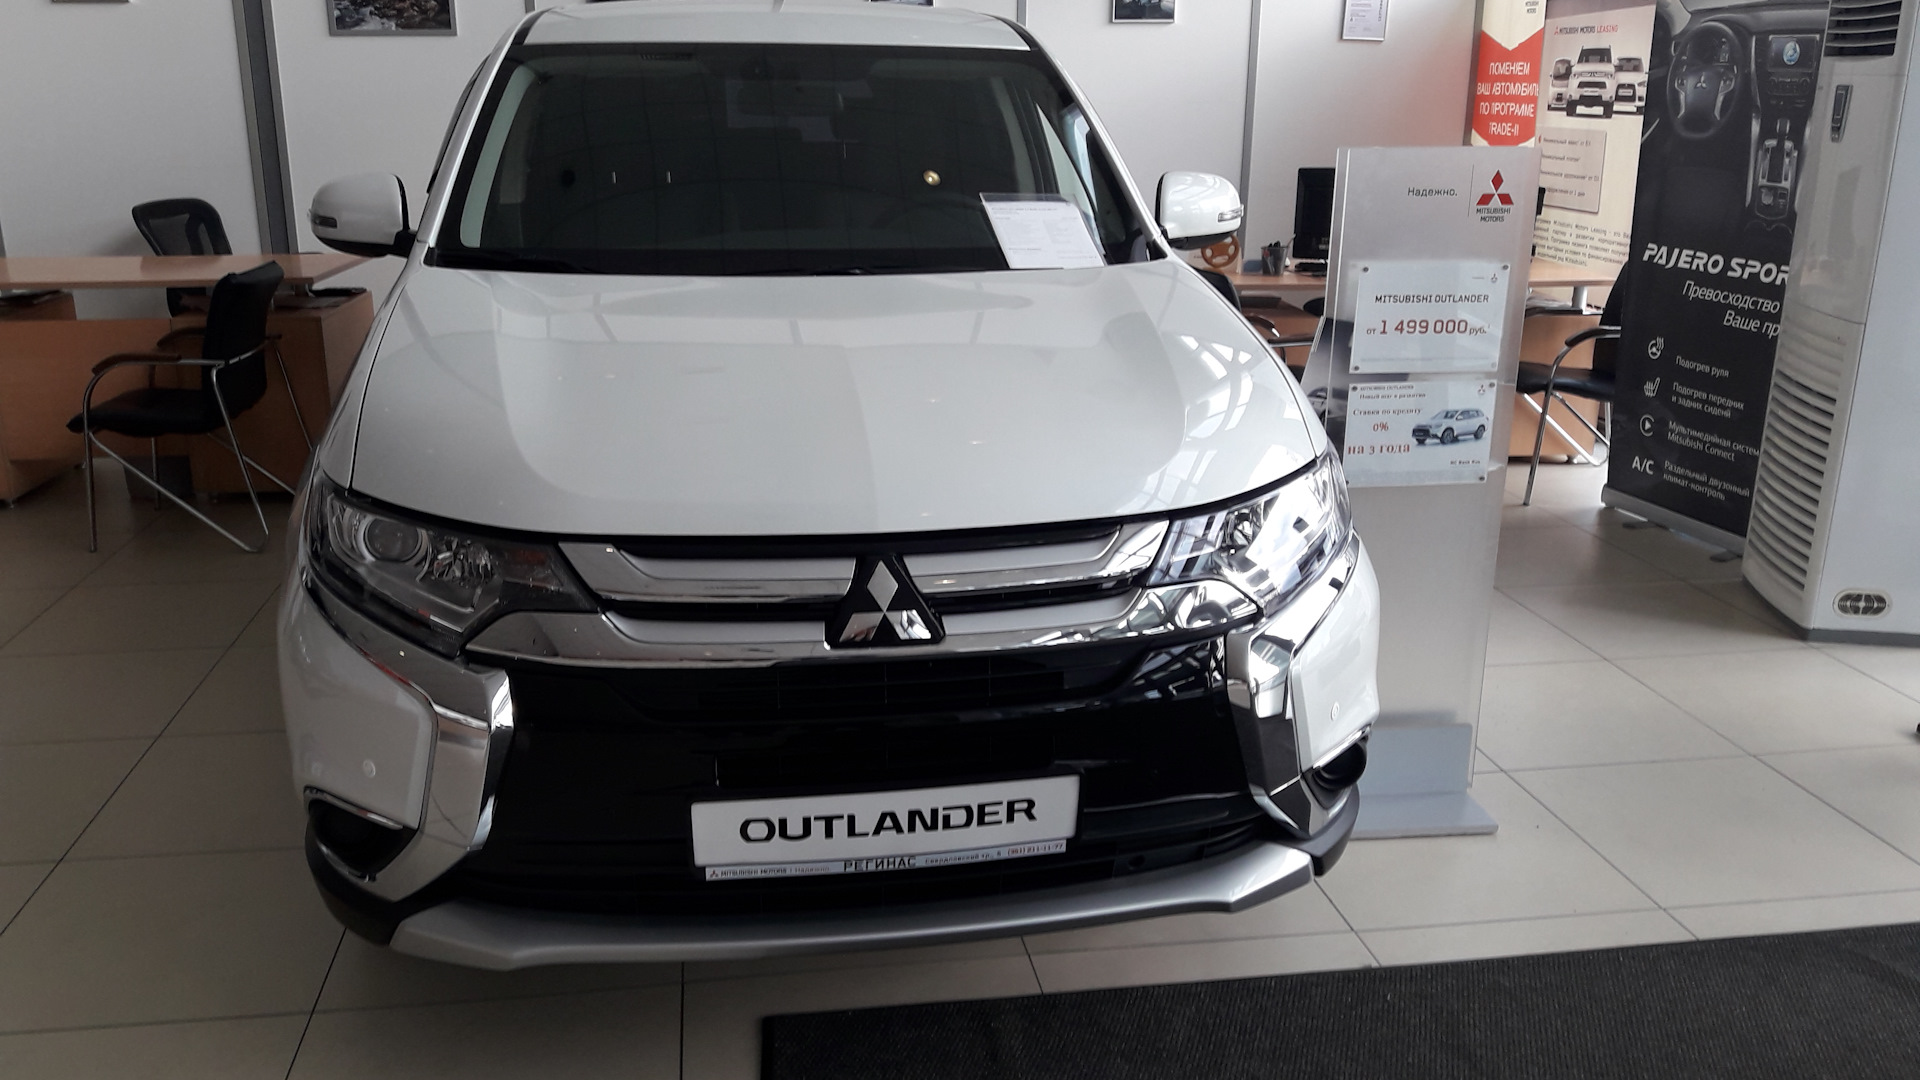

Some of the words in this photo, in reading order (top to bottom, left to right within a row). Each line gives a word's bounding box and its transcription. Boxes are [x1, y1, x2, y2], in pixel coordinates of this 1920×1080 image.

[1597, 24, 1619, 34] LEASING
[1489, 61, 1530, 76] ПОМЕНЯЕМ
[1477, 82, 1490, 96] ВАШ
[1480, 102, 1490, 116] ПО
[1491, 102, 1535, 118] ПРОГРАММЕ
[1407, 187, 1458, 198] Надежно.
[1476, 207, 1511, 215] MITSUBISHI
[1480, 215, 1505, 223] MOTORS
[1642, 242, 1724, 275] PAJERO
[1375, 294, 1433, 304] MITSUBISHI
[1435, 294, 1489, 304] OUTLANDER
[1683, 280, 1781, 314] Превосходство
[1366, 327, 1377, 335] от
[1380, 320, 1388, 335] 1
[1394, 319, 1429, 335] 499
[1433, 319, 1468, 335] 000
[1469, 326, 1487, 337] руб.
[1723, 309, 1760, 332] Ваше
[1675, 355, 1710, 374] Подогрев
[1711, 364, 1730, 379] руля
[1671, 395, 1677, 403] и
[1677, 397, 1703, 411] задних
[1673, 381, 1708, 400] Подогрев
[1708, 393, 1745, 411] передних
[1353, 408, 1380, 416] Ставка
[1392, 408, 1421, 417] кредиту
[1669, 420, 1731, 448] Мультимедийная
[1347, 444, 1364, 455] на
[1369, 445, 1375, 455] 3
[1379, 443, 1410, 455] года
[1668, 431, 1704, 451] Mitsubishi
[1705, 443, 1735, 462] Connect
[1632, 456, 1654, 475] A/C
[1663, 473, 1726, 501] климат-контроль
[1664, 460, 1707, 483] Раздельный
[1708, 477, 1750, 498] двузонный
[739, 798, 1037, 843] OUTLANDER
[844, 856, 916, 873] РЕГИНАС
